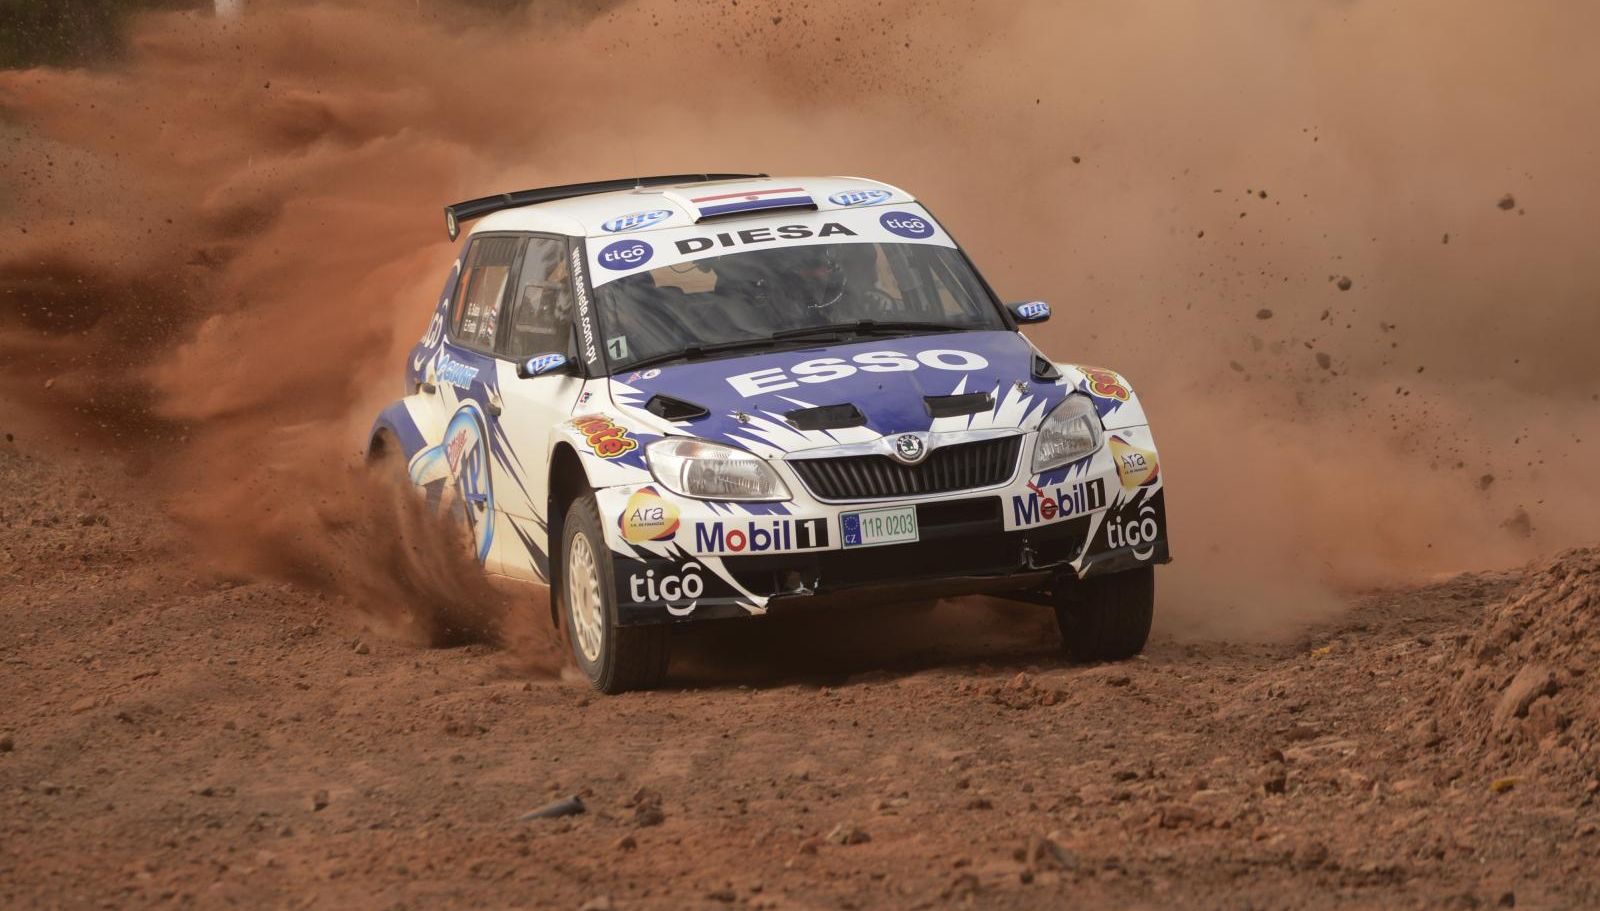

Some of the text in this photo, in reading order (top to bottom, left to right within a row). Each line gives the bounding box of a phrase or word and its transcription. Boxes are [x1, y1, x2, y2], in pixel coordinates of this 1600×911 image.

[675, 222, 858, 254] DIESA
[572, 246, 597, 365] www.senete.com.py
[609, 339, 626, 359] 1
[726, 349, 989, 398] ESSO
[1122, 452, 1147, 471] Ara
[630, 506, 665, 523] Ara
[1013, 484, 1088, 527] Mobil
[696, 520, 791, 553] Mobil
[845, 535, 857, 544] CZ
[862, 512, 914, 538] 11R 0203
